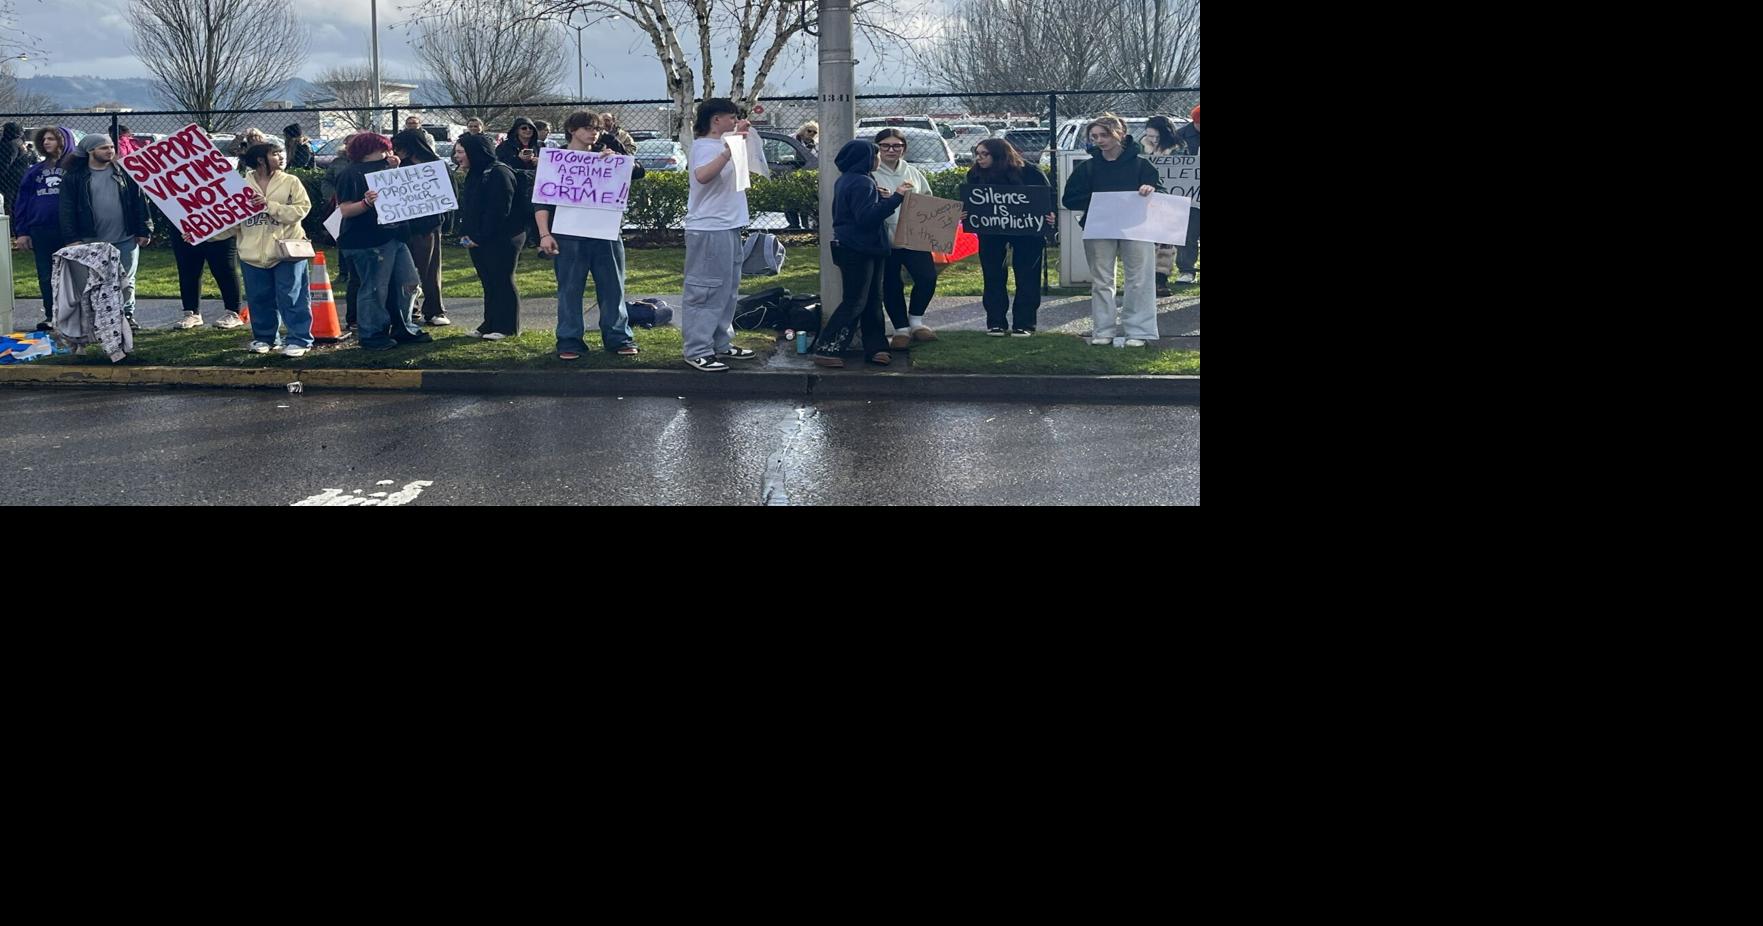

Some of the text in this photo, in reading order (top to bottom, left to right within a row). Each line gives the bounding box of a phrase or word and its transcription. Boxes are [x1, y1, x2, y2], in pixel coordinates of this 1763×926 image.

[123, 124, 213, 183] SUPPORT
[1180, 156, 1196, 165] TO
[144, 150, 233, 200] VICTIMS
[558, 164, 613, 178] A CRIME
[582, 177, 593, 188] A
[177, 177, 229, 214] NOT
[969, 187, 1030, 205] Silence
[381, 194, 455, 221] STUDENTS
